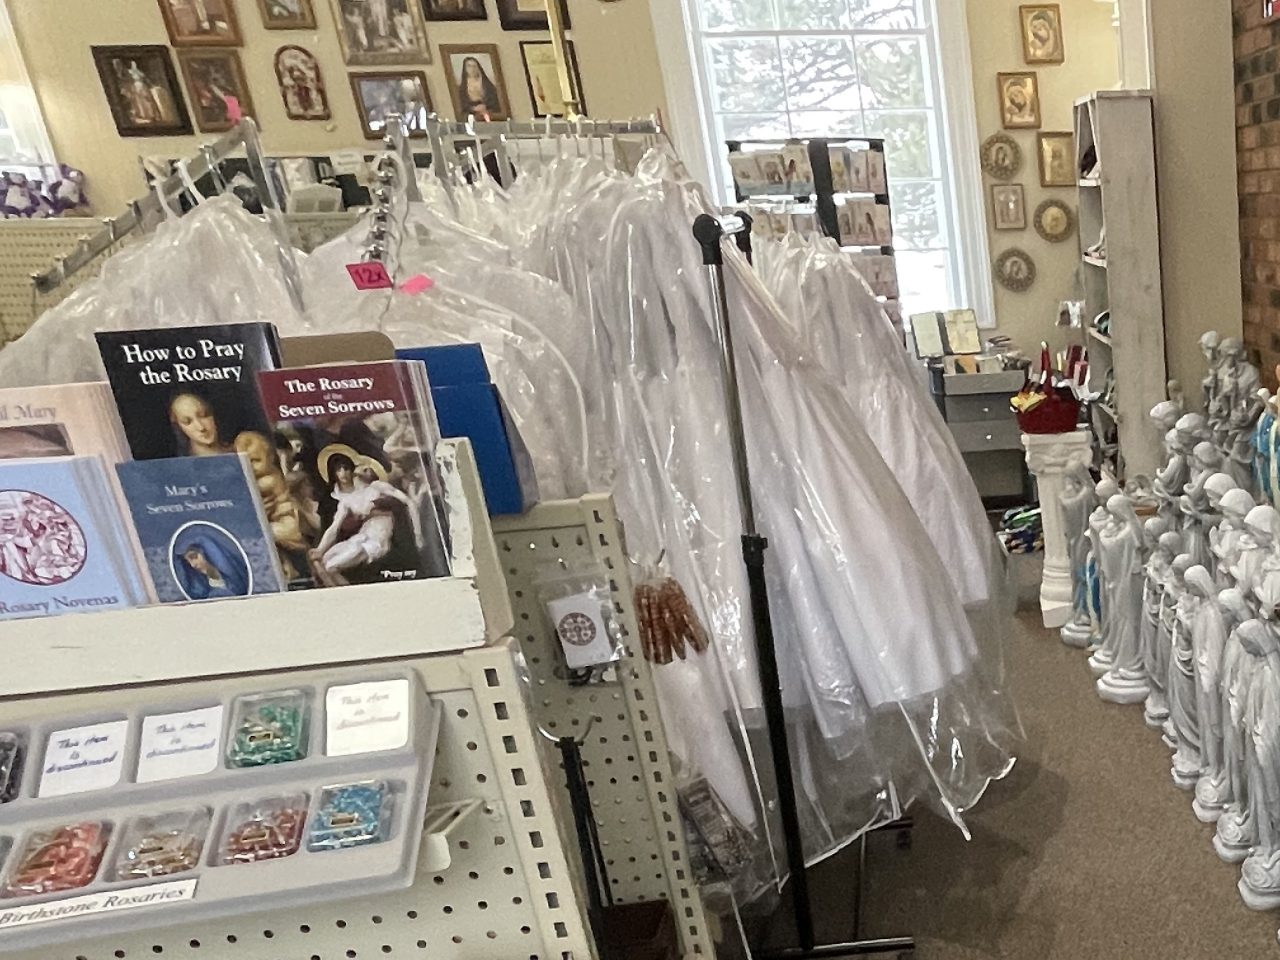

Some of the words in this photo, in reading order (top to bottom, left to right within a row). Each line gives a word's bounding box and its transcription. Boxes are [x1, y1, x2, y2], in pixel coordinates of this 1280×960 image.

[120, 343, 170, 363] How
[175, 345, 196, 360] to
[197, 339, 244, 360] Pray
[140, 364, 171, 385] the
[172, 363, 242, 382] Rosary
[284, 379, 316, 394] The
[319, 377, 374, 391] Rosary
[279, 404, 325, 418] Seven
[327, 399, 395, 414] Sorrows
[164, 482, 208, 496] Mary's
[52, 595, 119, 610] Novenas
[0, 899, 99, 924] Birthstone
[103, 887, 187, 908] Rosaries
